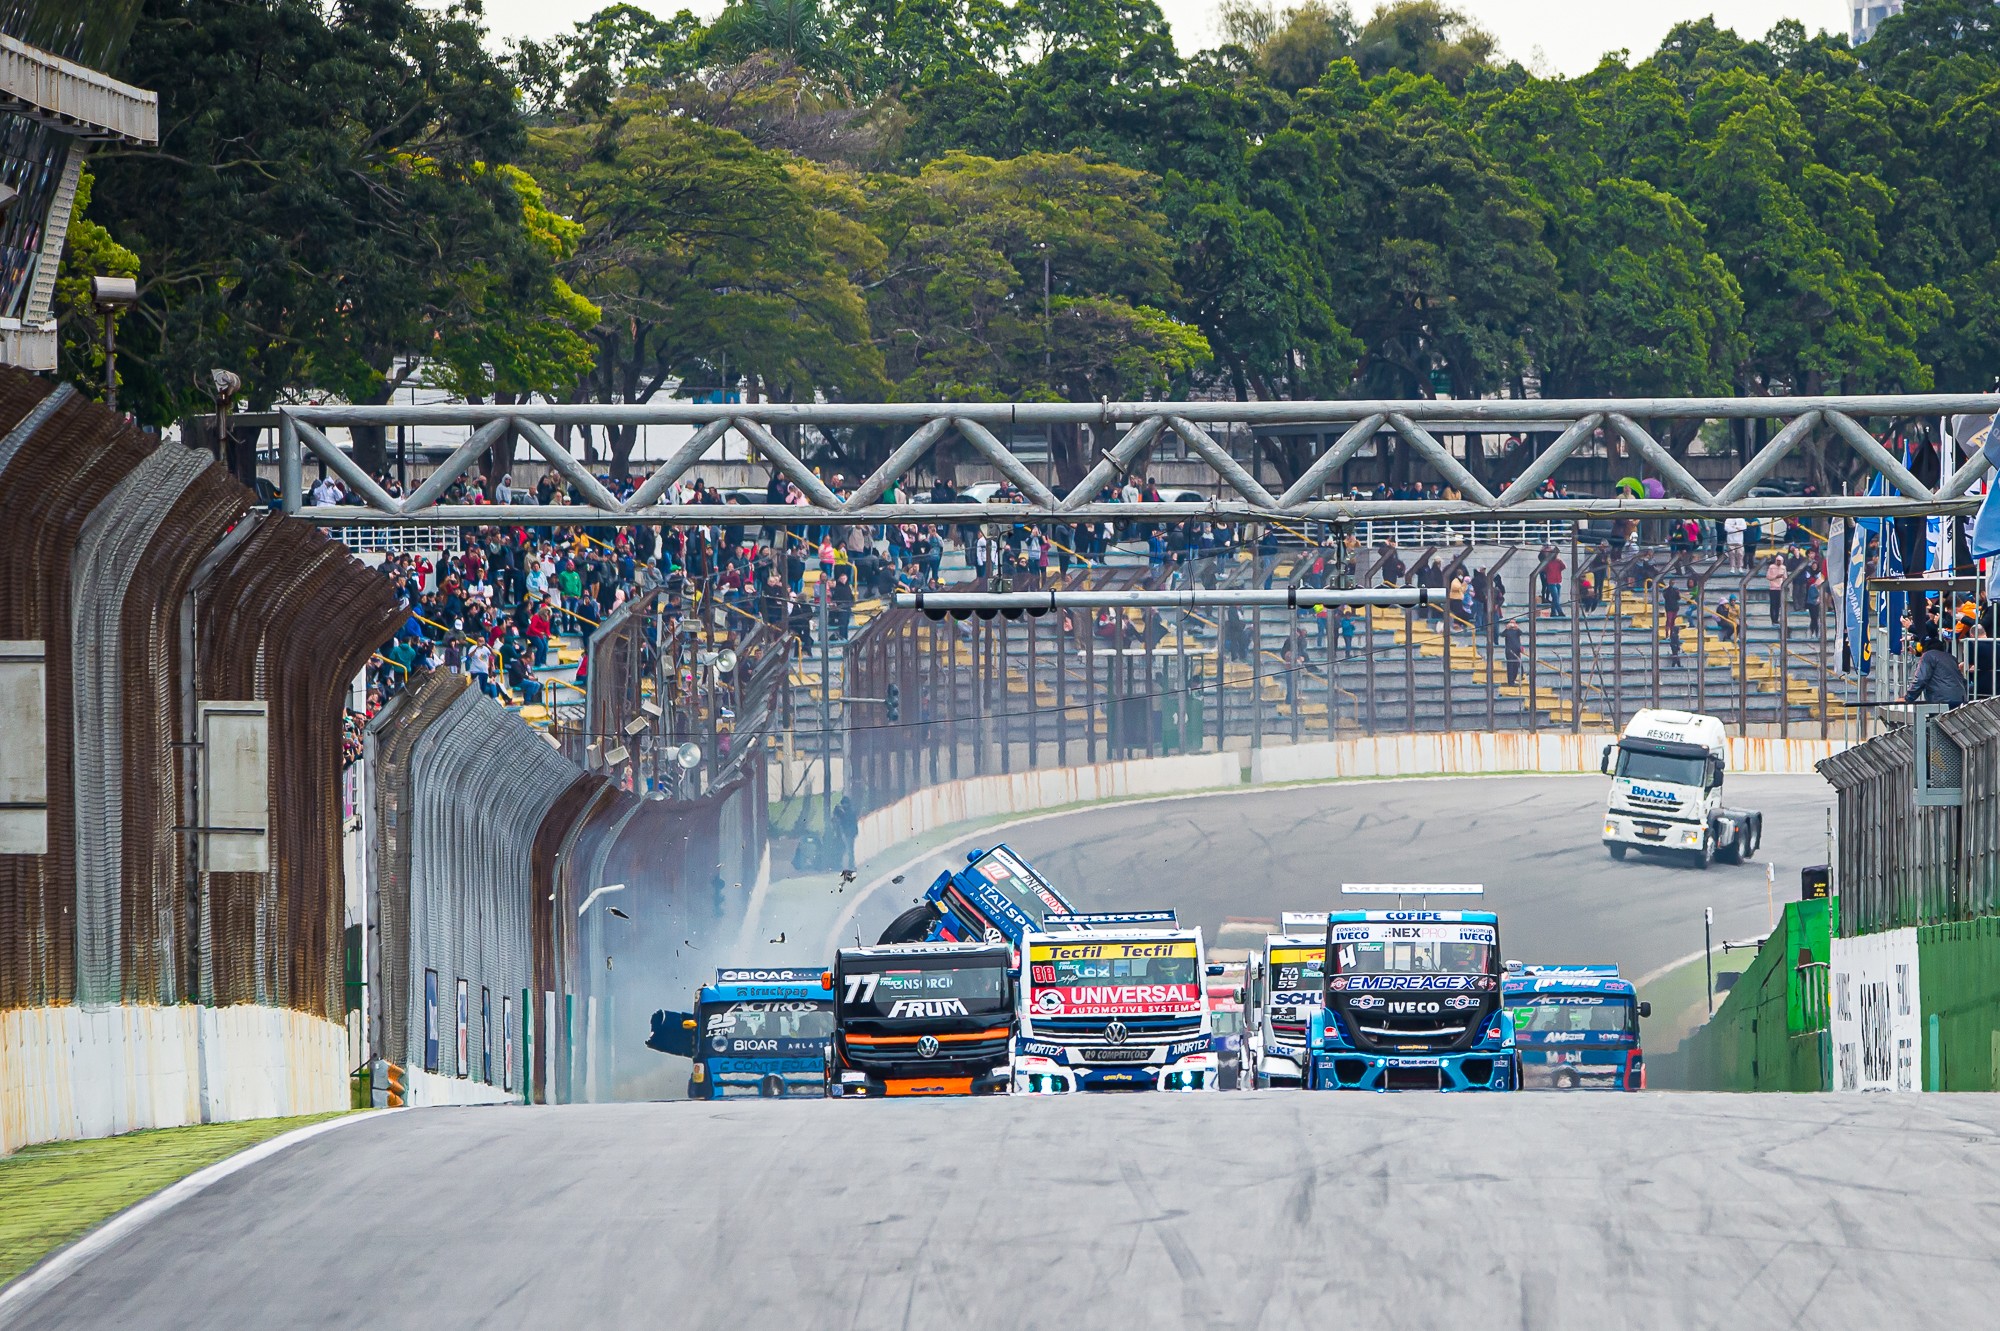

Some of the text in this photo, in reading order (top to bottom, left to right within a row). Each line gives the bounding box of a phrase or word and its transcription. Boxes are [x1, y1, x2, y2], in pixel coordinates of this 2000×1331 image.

[1647, 729, 1685, 742] RESGATE
[1631, 786, 1677, 800] BRAZUL
[978, 882, 1035, 933] ITALSPE
[1046, 913, 1172, 923] MERITOR
[1386, 912, 1441, 920] COFIPE
[1336, 931, 1369, 940] IVECO
[1459, 933, 1493, 942] IVECO
[1050, 945, 1173, 959] Tecfil Tecfil
[737, 970, 794, 980] BIOAR
[1032, 965, 1056, 983] 88
[844, 974, 880, 1003] 77
[1348, 976, 1478, 990] EMBREAGEX
[750, 987, 808, 998] truckpag
[1070, 984, 1195, 1004] UNIVERSAL
[1526, 994, 1604, 1005] ACTROS
[726, 1001, 819, 1013] ACTROS
[887, 998, 969, 1018] FRUM
[1071, 1004, 1195, 1014] AUTOMOTIVE SYSTEMS
[1388, 1002, 1440, 1014] IVECO
[707, 1013, 737, 1030] 25
[733, 1039, 778, 1051] BIOAR
[1172, 1039, 1210, 1055] AMORTEX
